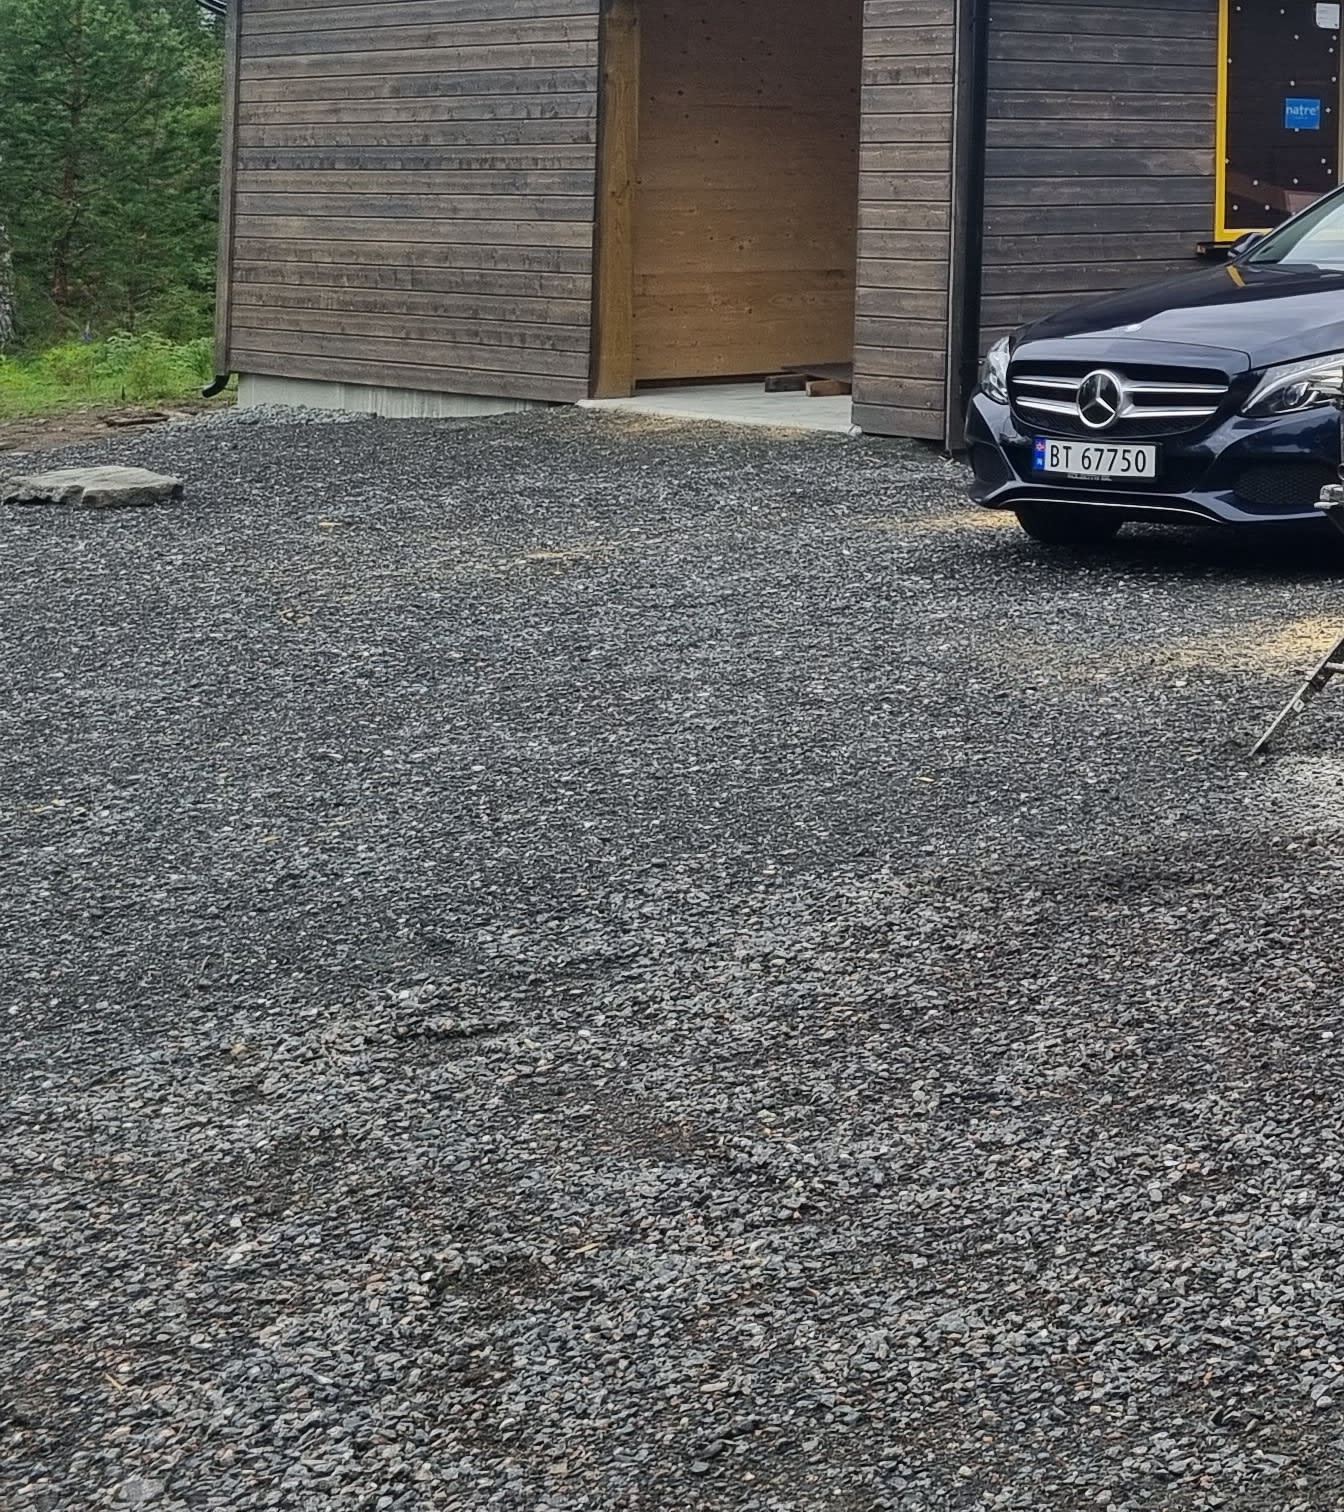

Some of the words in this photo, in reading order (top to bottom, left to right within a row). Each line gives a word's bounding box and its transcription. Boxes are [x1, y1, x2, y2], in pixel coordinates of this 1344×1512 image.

[1286, 104, 1317, 116] natre
[1050, 444, 1073, 469] BT
[1081, 447, 1147, 473] 67750
